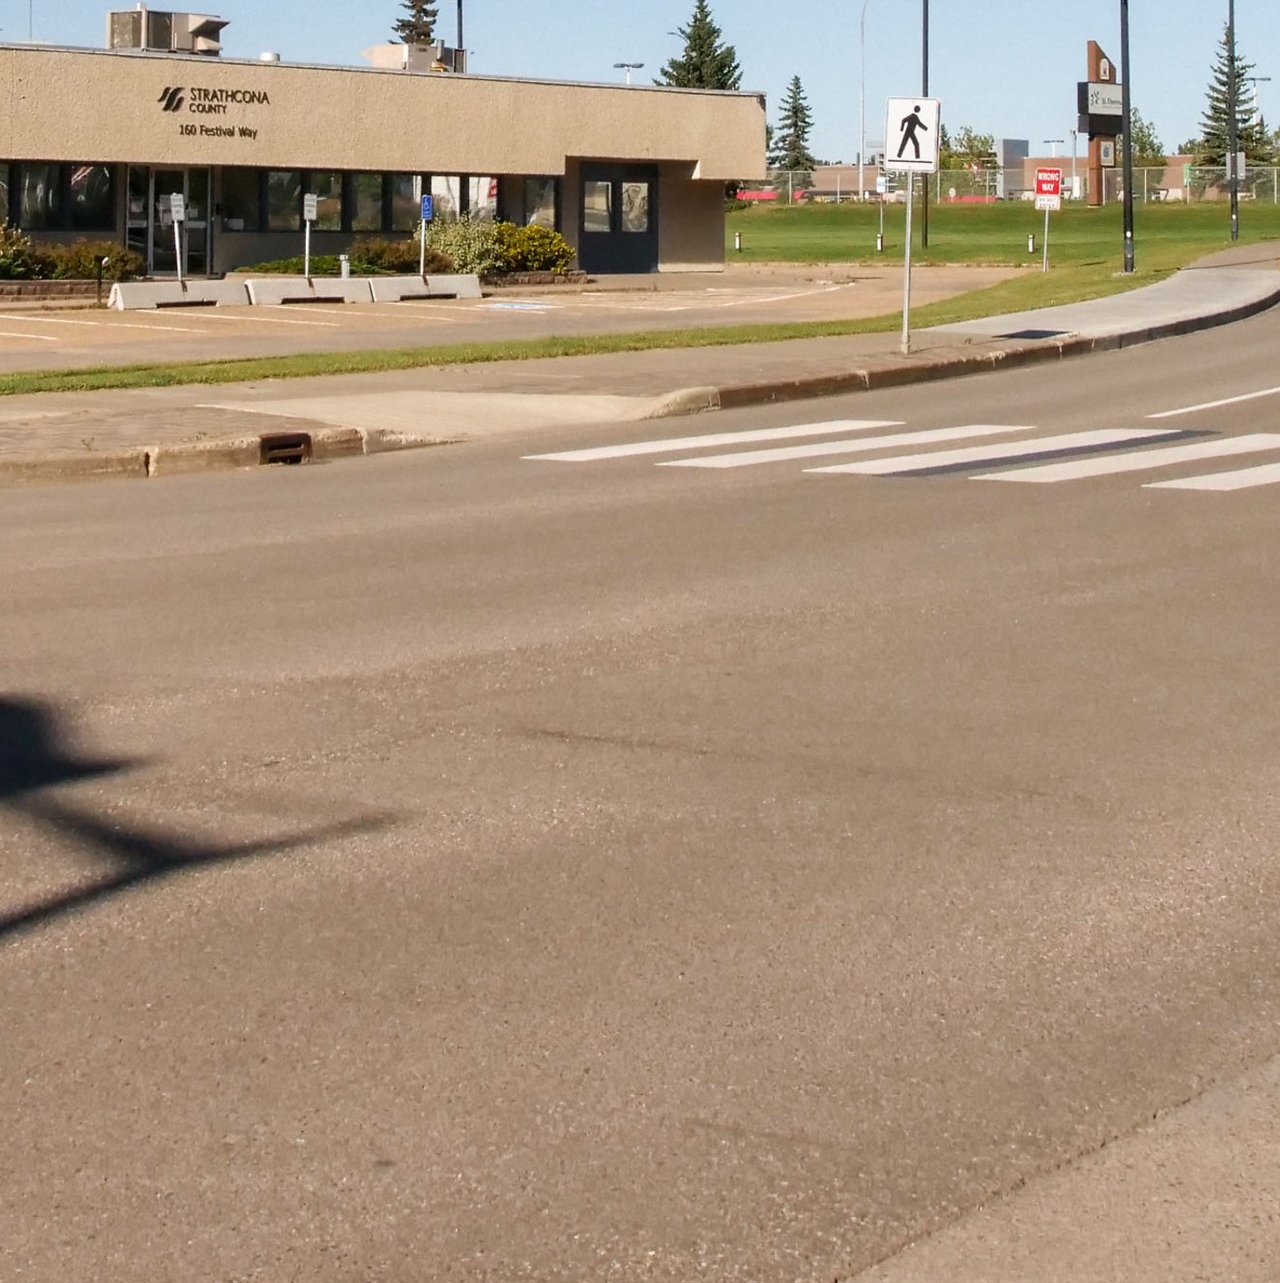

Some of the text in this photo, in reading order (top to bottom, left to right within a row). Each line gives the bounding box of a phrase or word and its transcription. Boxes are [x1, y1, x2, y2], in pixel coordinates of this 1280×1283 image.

[190, 87, 270, 105] STRATHCONA
[189, 103, 227, 114] COUNTY
[179, 124, 258, 140] 160 Festival Way
[1038, 172, 1060, 181] WRONG
[1041, 183, 1055, 191] WAY
